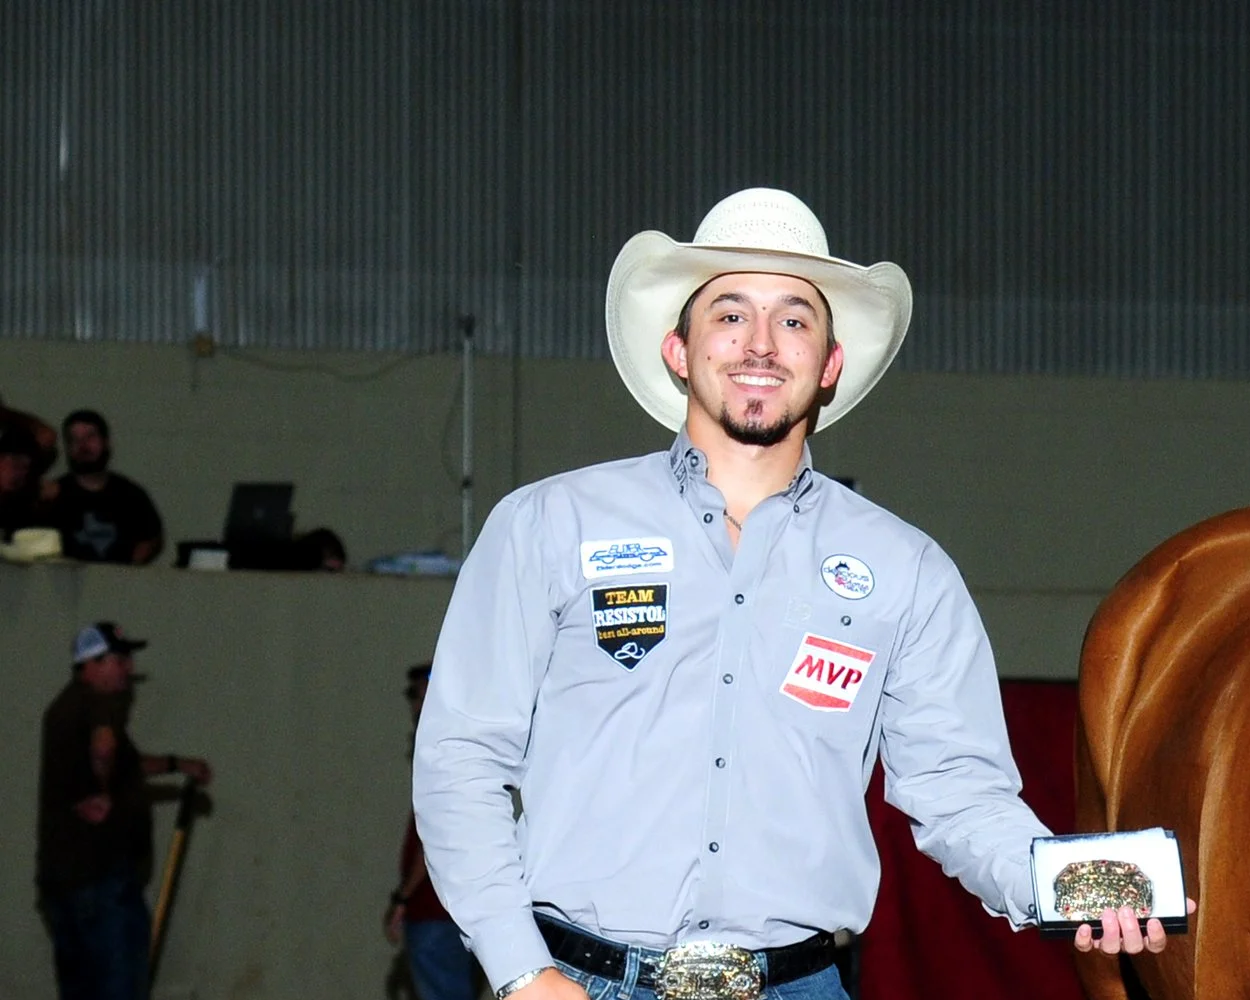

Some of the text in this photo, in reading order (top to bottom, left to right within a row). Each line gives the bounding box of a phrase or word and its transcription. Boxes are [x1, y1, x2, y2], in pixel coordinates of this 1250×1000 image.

[605, 589, 655, 605] TEAM
[592, 605, 666, 627] RESISTOL
[616, 624, 665, 637] all-around
[795, 654, 863, 690] MVP
